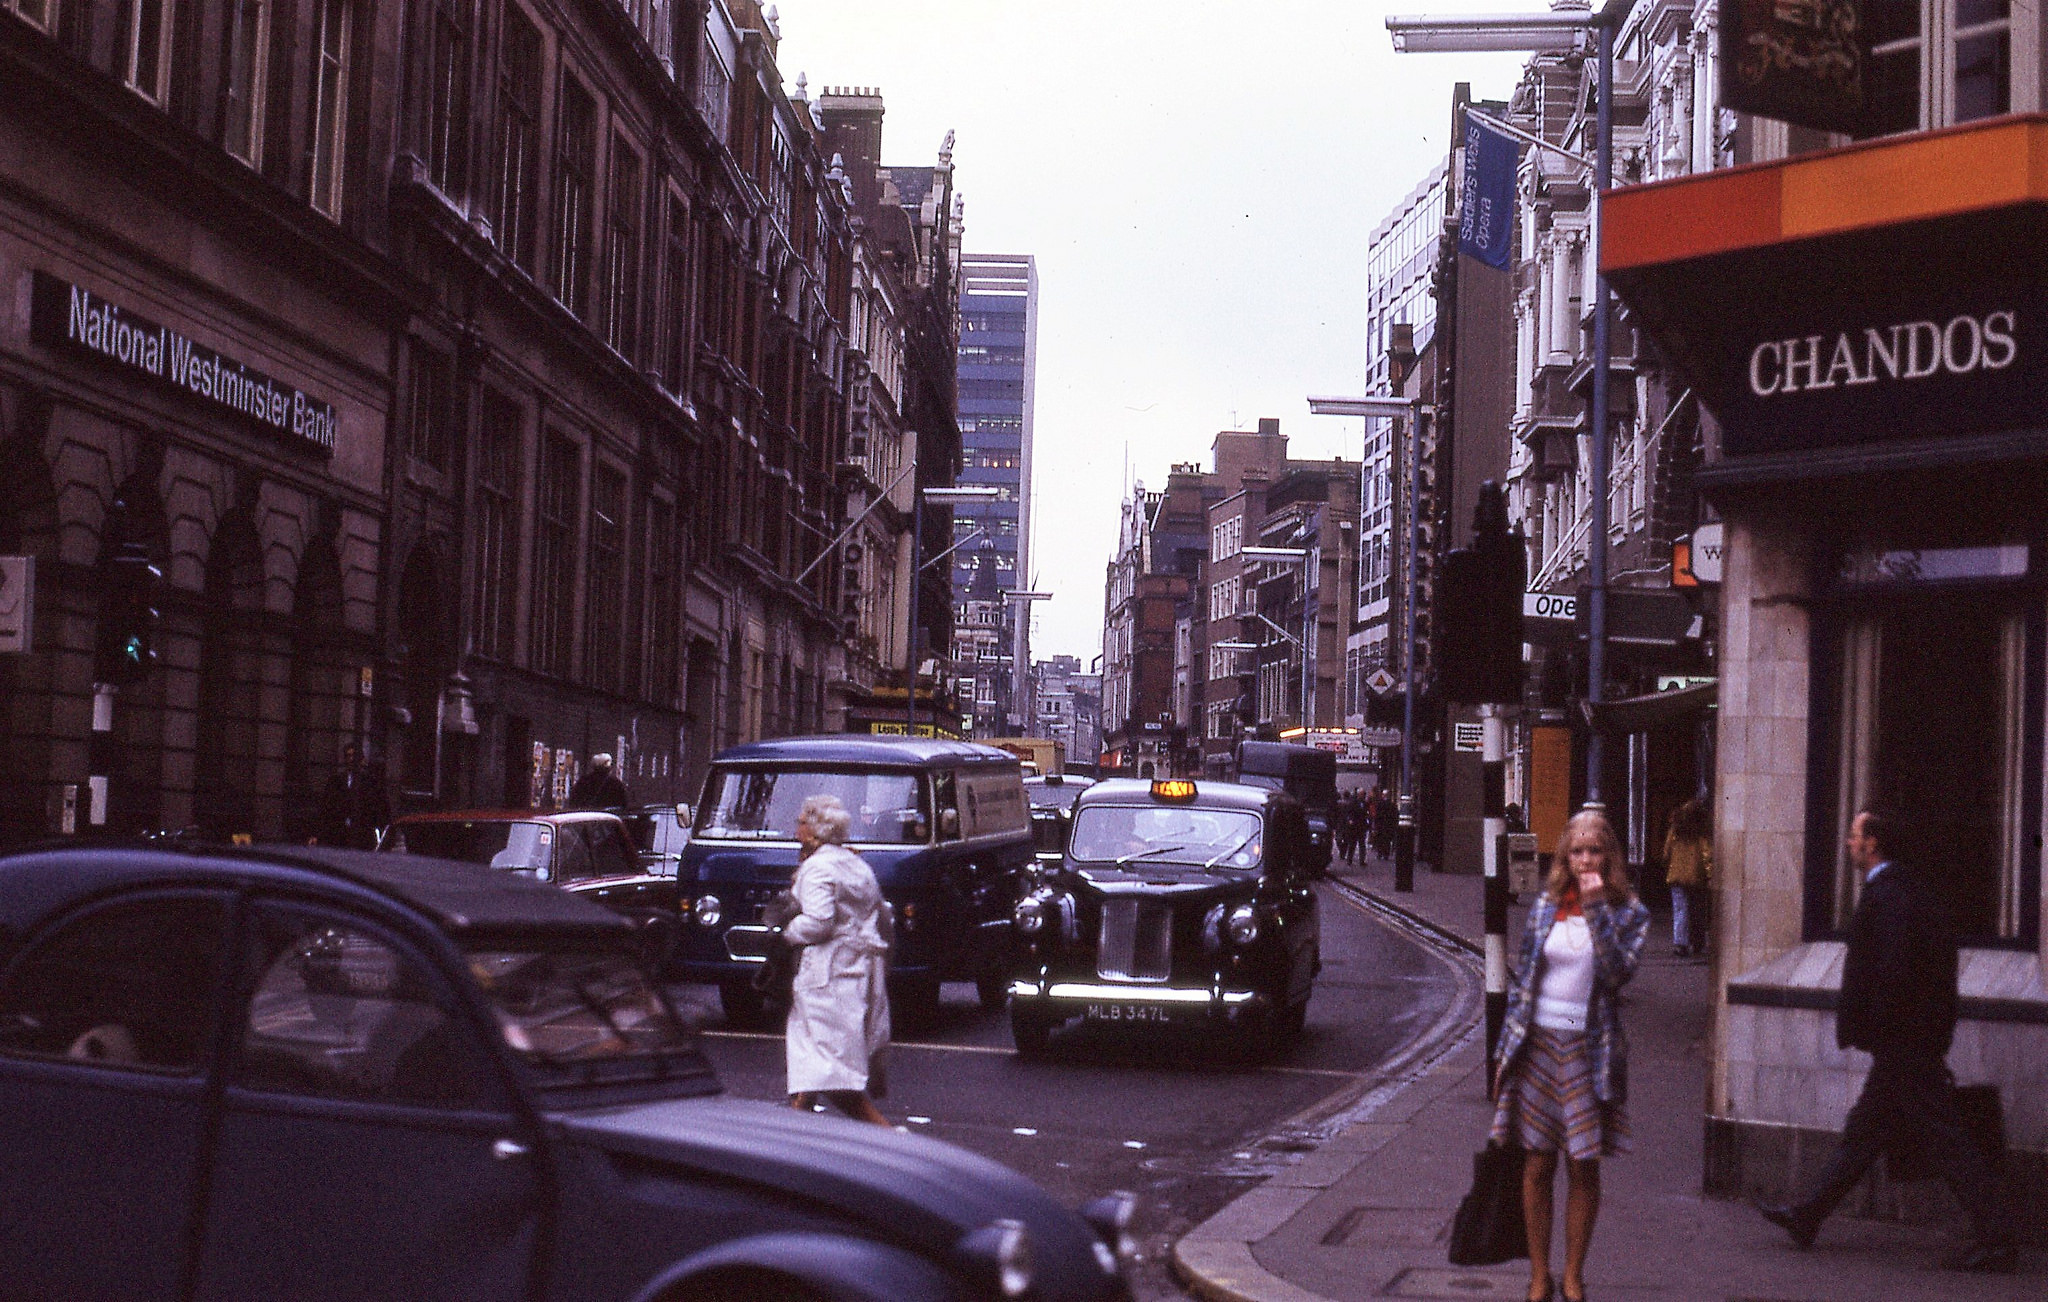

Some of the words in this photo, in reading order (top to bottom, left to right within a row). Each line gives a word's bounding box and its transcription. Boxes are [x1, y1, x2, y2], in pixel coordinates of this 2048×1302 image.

[1466, 126, 1481, 171] Wells
[1475, 197, 1492, 249] Opera
[68, 283, 165, 376] National
[170, 332, 290, 428] Westminster
[293, 390, 336, 448] Bank
[1749, 311, 2017, 396] CHANDOS
[1088, 1004, 1121, 1020] MLB
[1126, 1005, 1170, 1021] 347L
